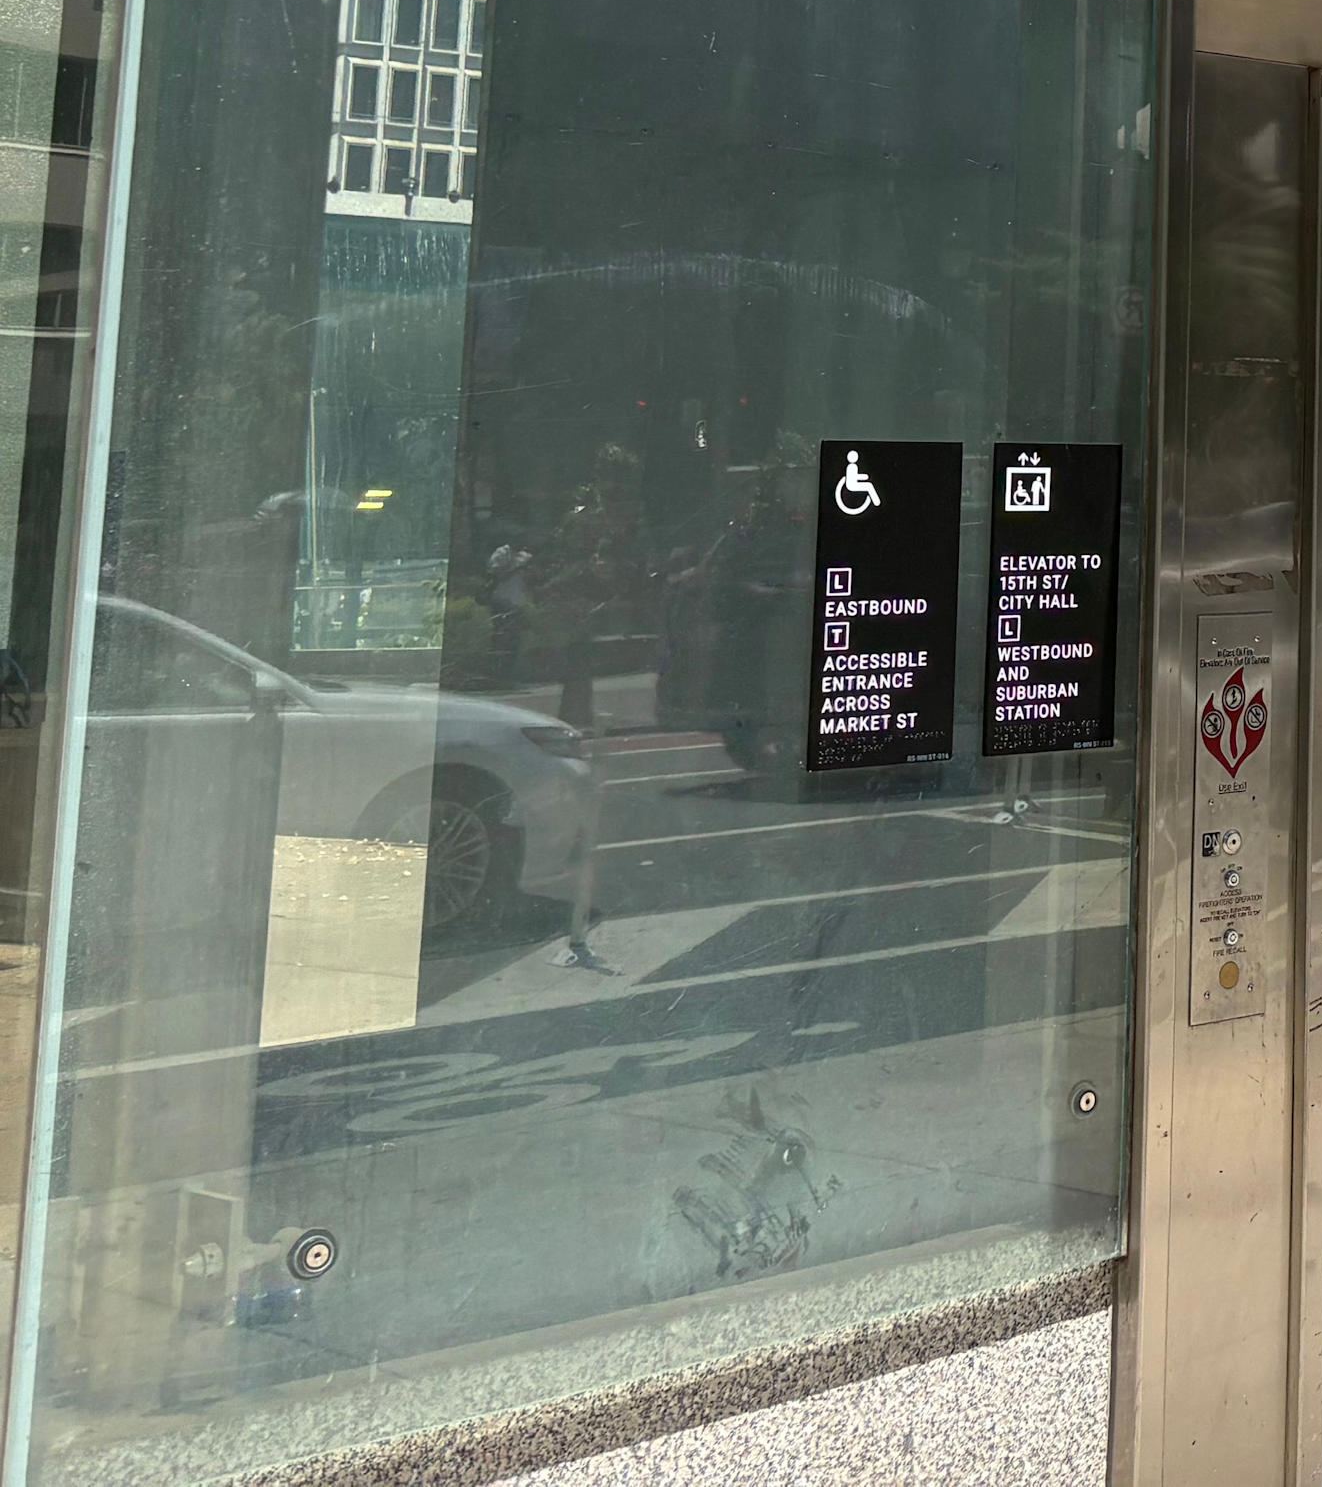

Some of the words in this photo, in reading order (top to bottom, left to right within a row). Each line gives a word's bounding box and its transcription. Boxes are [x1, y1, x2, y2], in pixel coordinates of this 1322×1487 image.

[1000, 555, 1077, 571] ELEVATOR
[1081, 554, 1102, 569] TO
[834, 574, 844, 590] L
[999, 575, 1037, 591] 15TH
[1042, 574, 1069, 590] ST/
[824, 598, 928, 617] EASTBOUND
[998, 594, 1034, 611] CITY
[1038, 593, 1078, 609] HALL
[831, 628, 843, 644] T
[1004, 620, 1014, 636] L
[823, 651, 928, 672] ACCESSIBLE
[997, 643, 1093, 662] WESTBOUND
[821, 672, 914, 693] ENTRANCE
[996, 666, 1030, 682] AND
[995, 682, 1079, 701] SUBURBAN
[821, 695, 891, 713] ACROSS
[994, 702, 1061, 721] STATION
[819, 714, 889, 735] MARKET
[896, 712, 918, 729] ST
